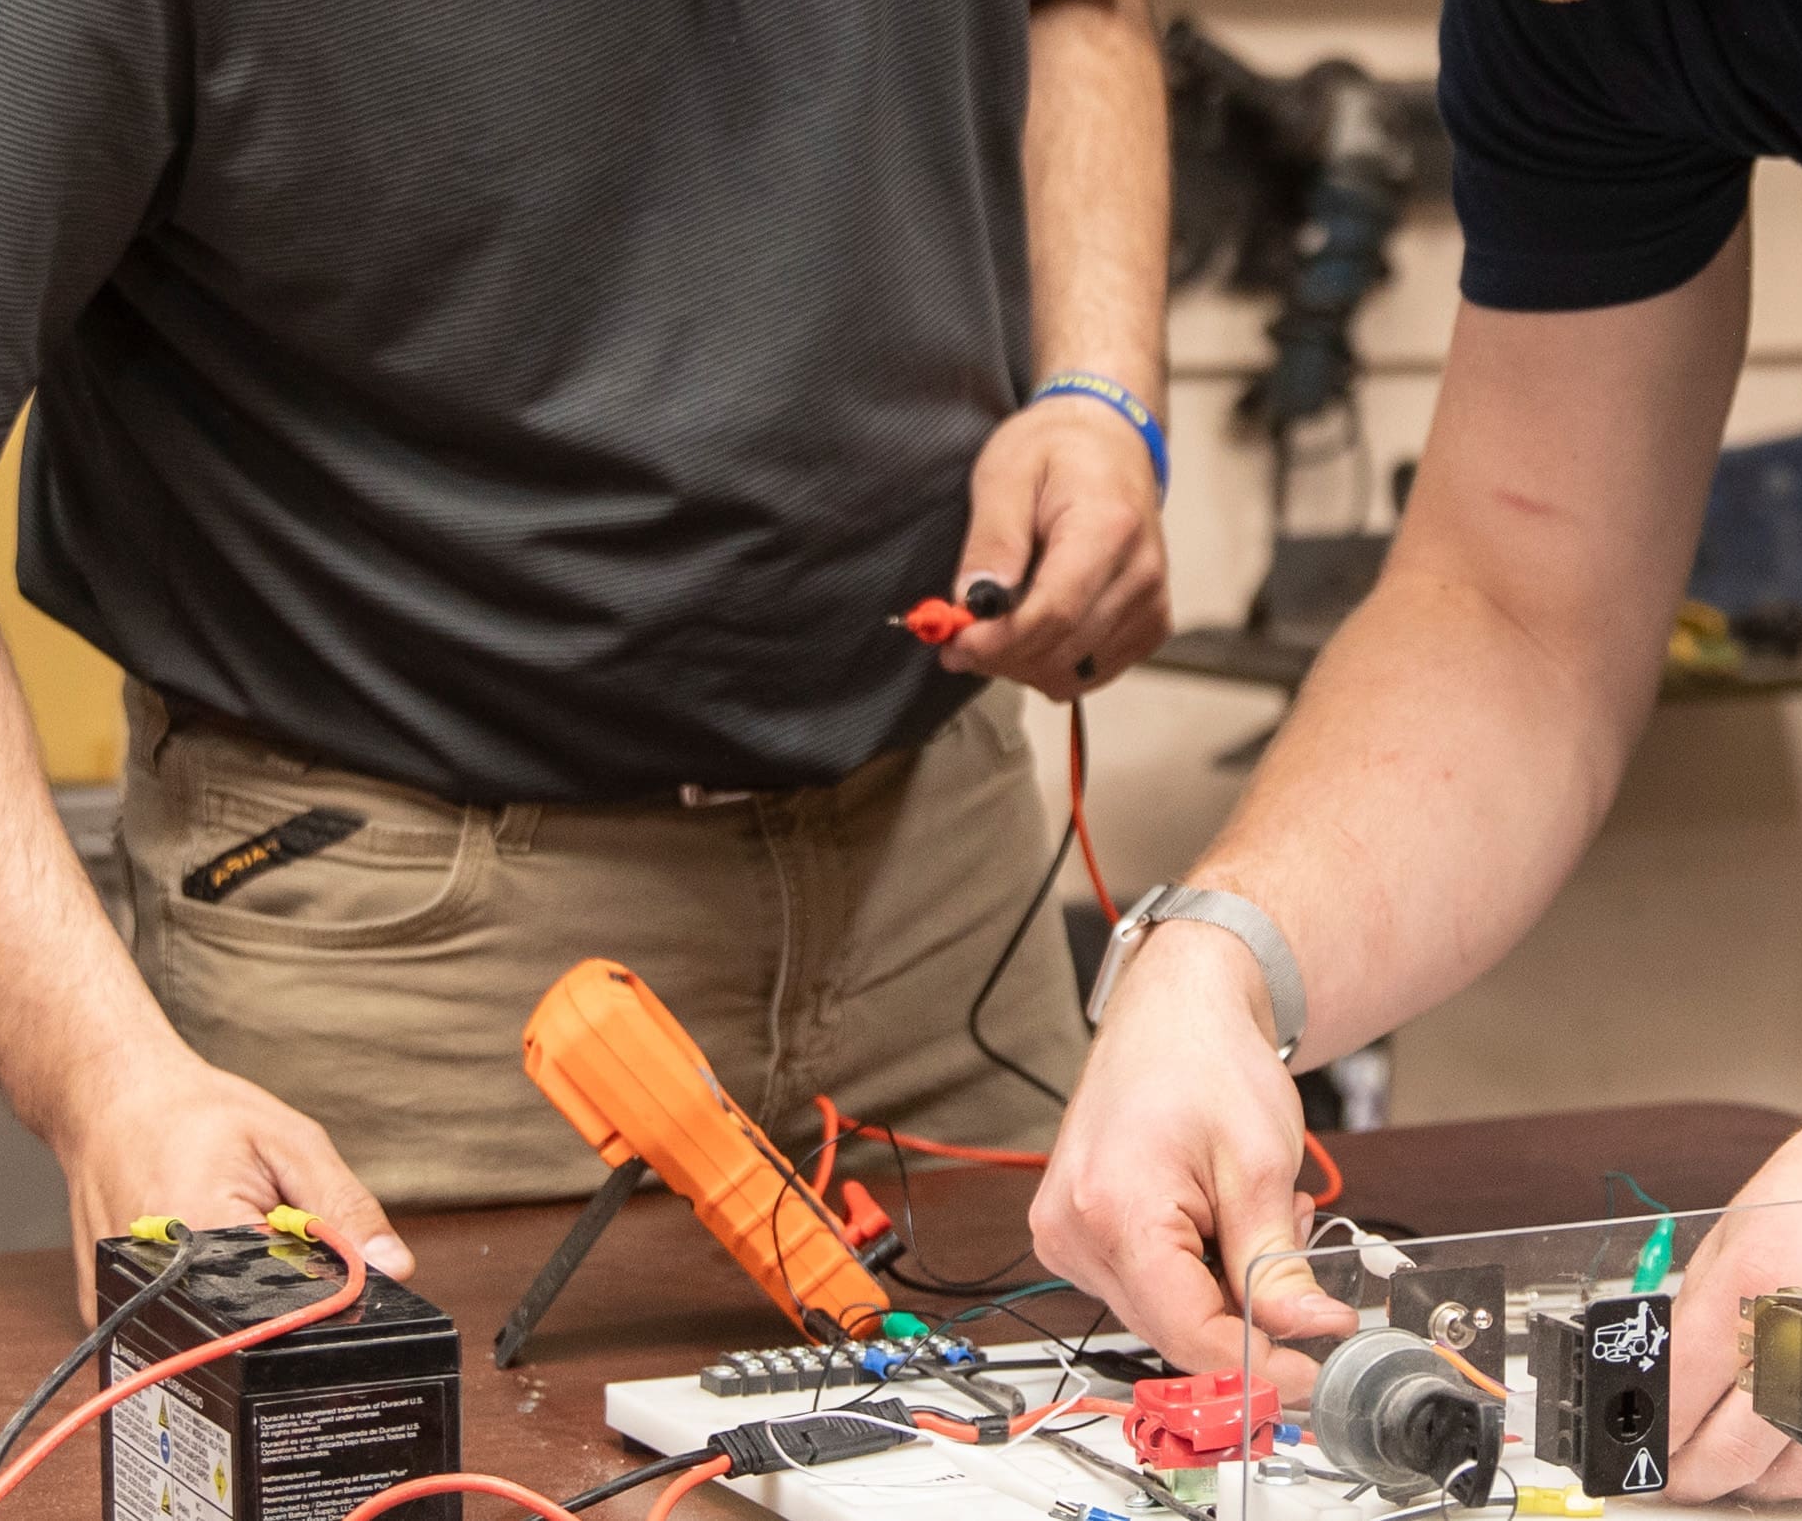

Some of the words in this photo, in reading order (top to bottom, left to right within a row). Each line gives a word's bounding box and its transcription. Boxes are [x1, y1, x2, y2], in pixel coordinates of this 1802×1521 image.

[260, 1413, 289, 1423] Duracell
[338, 1404, 371, 1414] trademark
[381, 1399, 408, 1409] Duracell
[261, 1439, 289, 1449] Duracell
[379, 1425, 405, 1434] Duracell
[262, 1482, 306, 1493] Replacement
[322, 1477, 351, 1487] recycling
